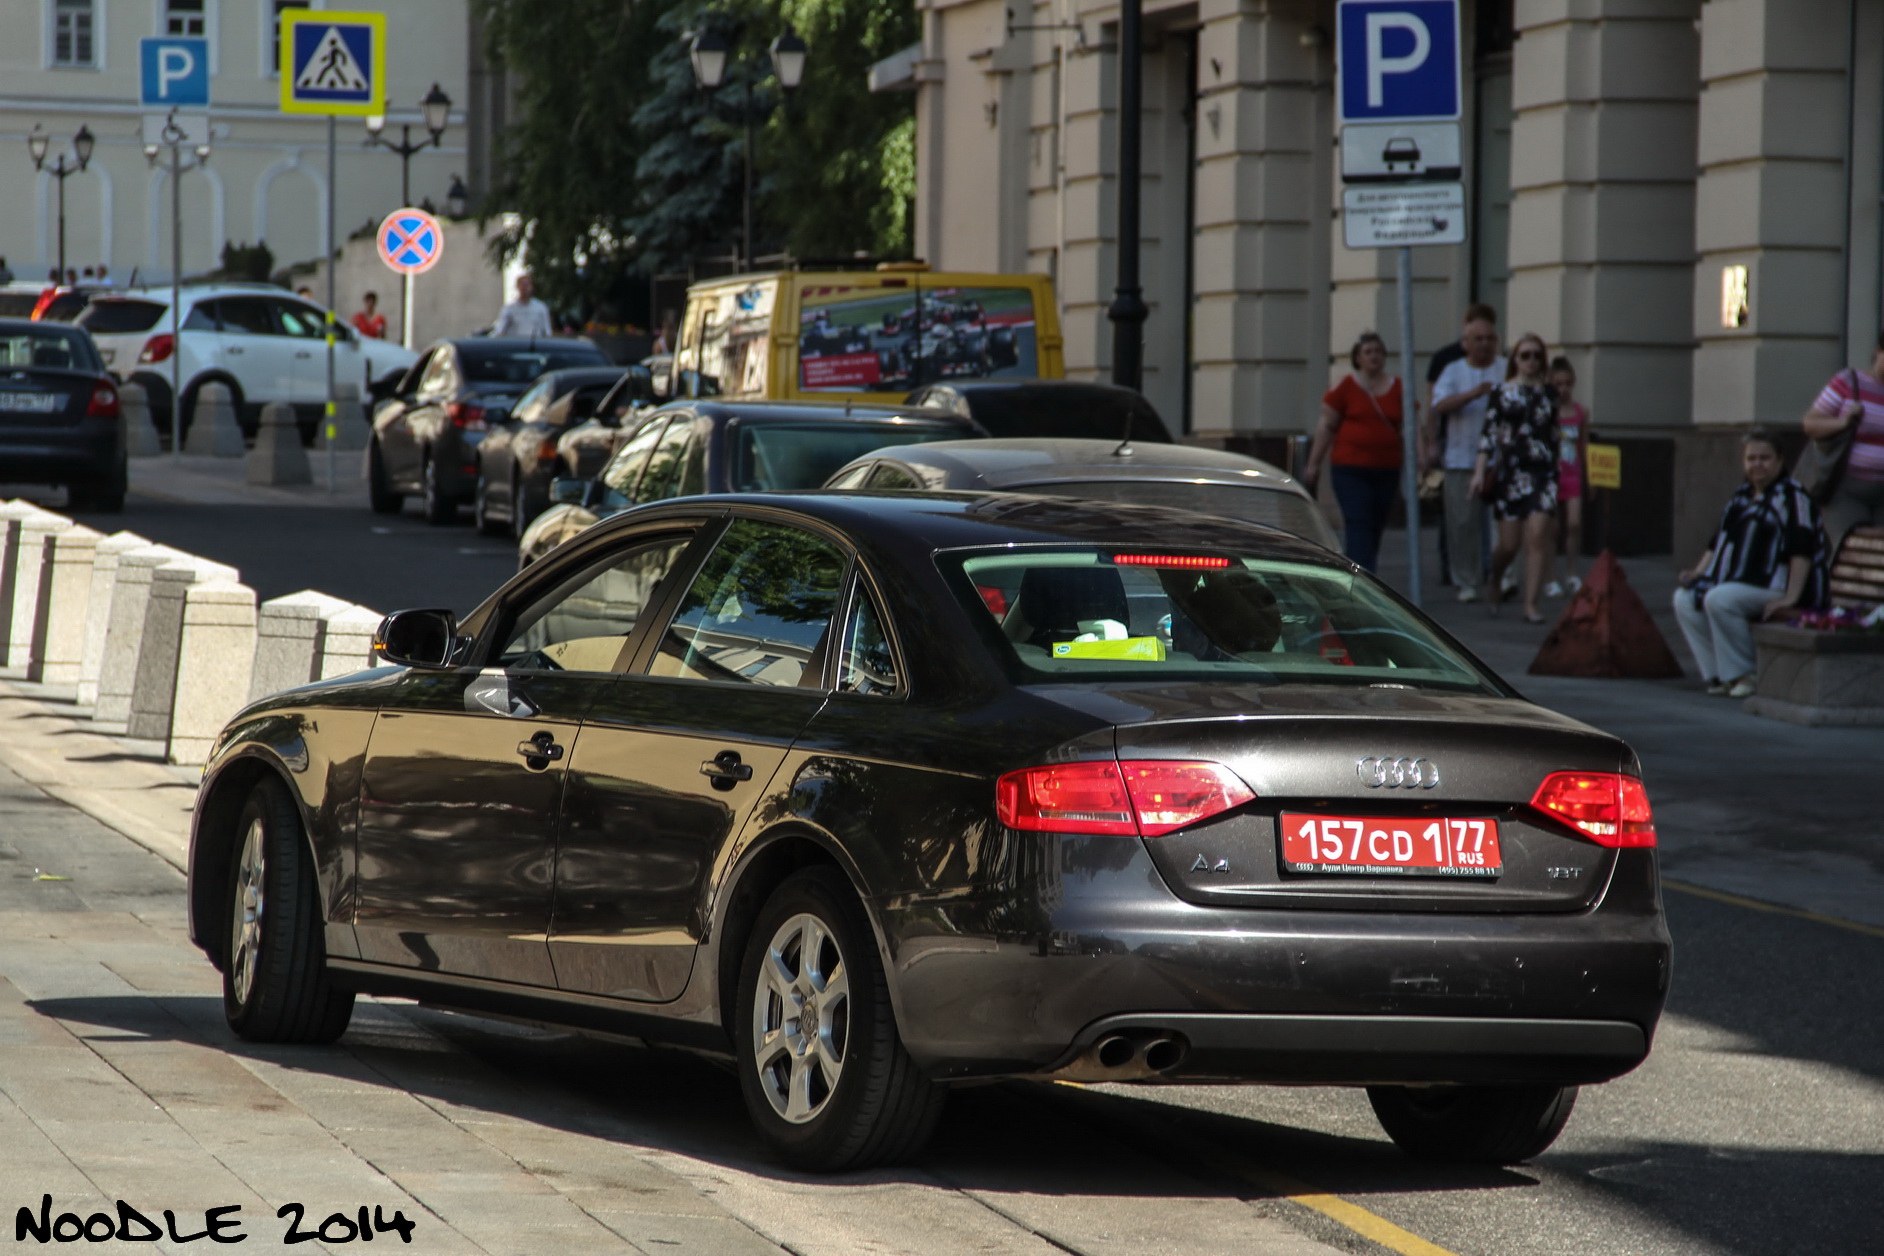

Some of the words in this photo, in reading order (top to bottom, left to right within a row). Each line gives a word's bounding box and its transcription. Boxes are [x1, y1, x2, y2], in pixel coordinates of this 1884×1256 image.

[158, 46, 194, 98] P
[1366, 12, 1431, 108] P
[1321, 863, 1341, 873] Ауди
[1342, 863, 1365, 873] Центр
[1457, 852, 1485, 865] RUS
